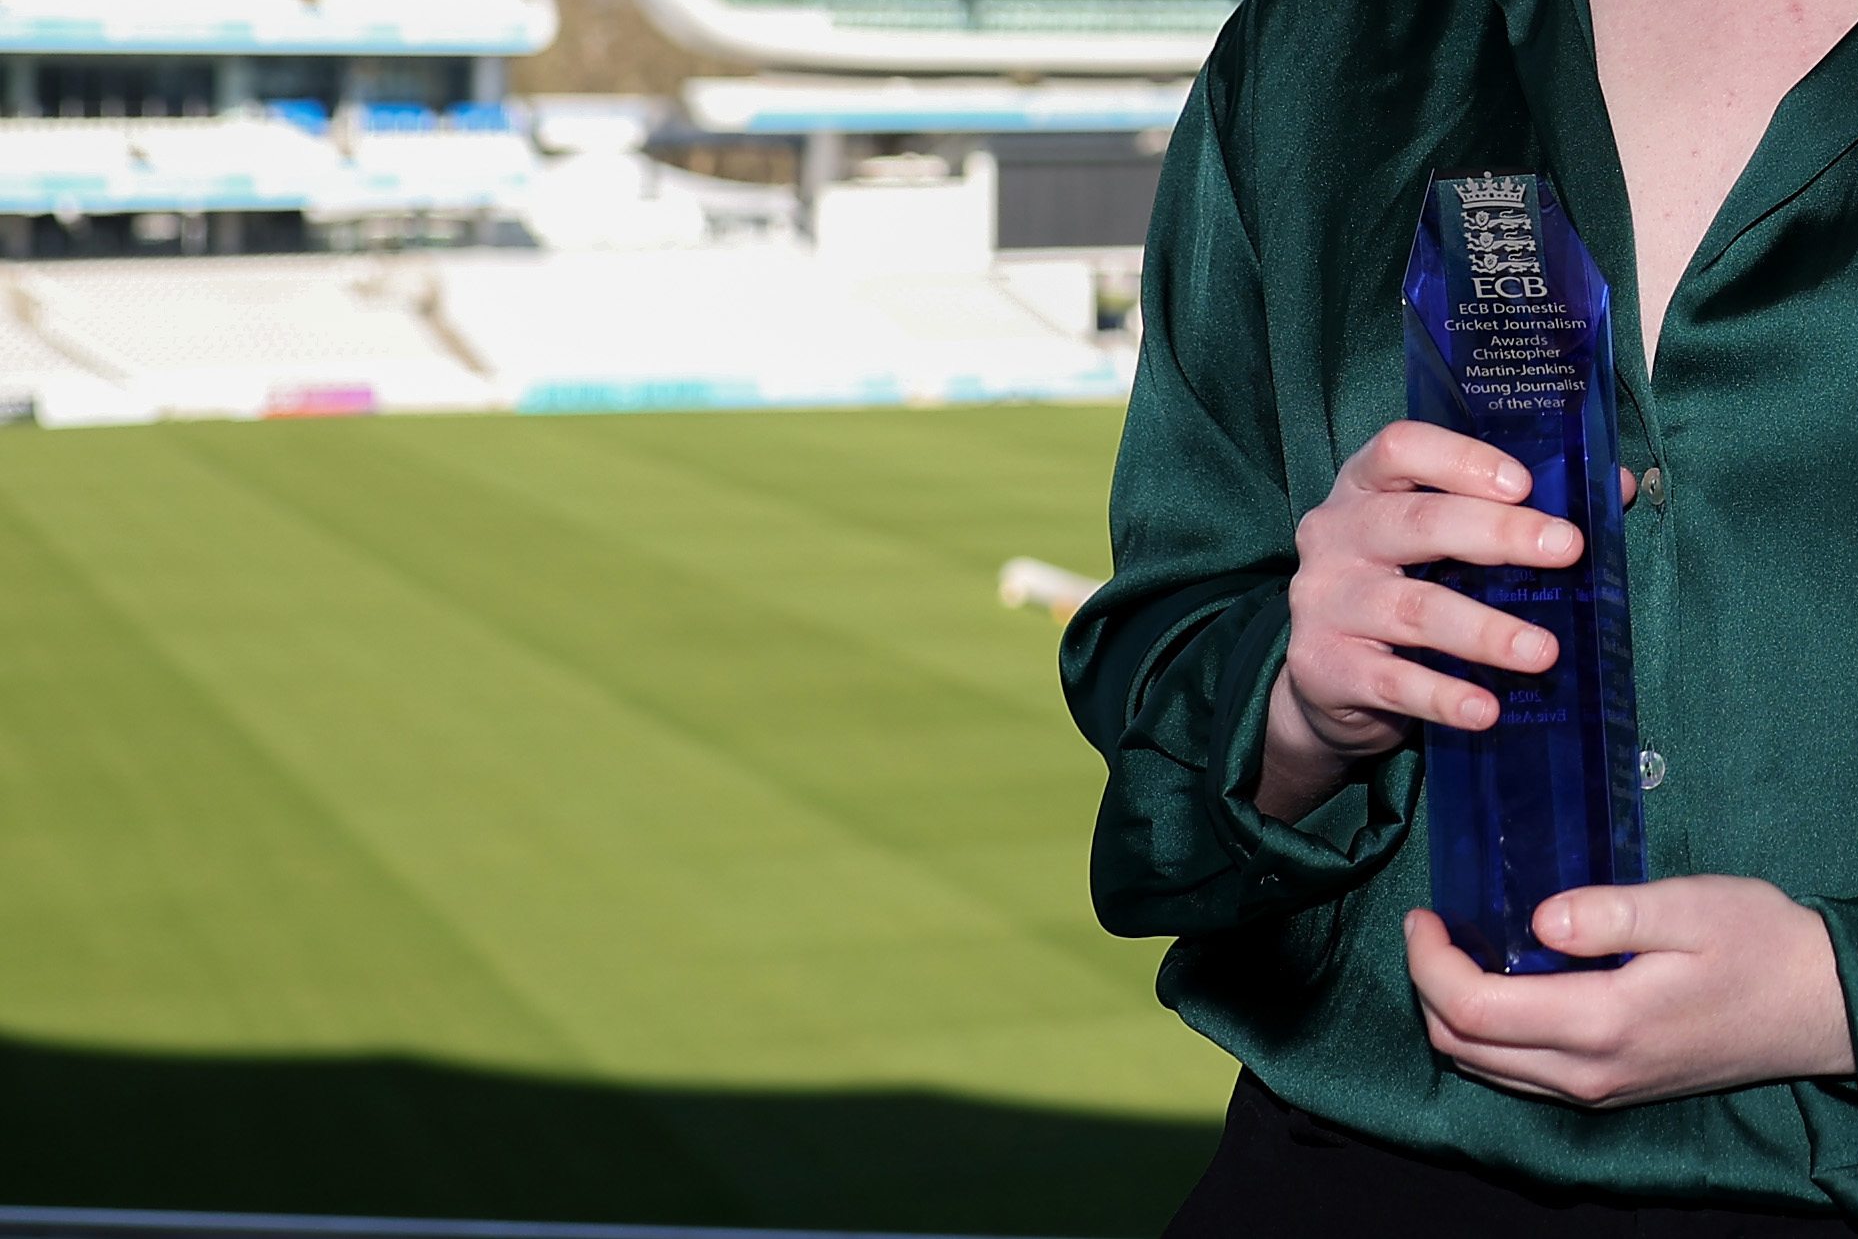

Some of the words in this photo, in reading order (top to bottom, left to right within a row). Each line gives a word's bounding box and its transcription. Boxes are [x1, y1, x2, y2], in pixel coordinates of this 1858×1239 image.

[1471, 276, 1548, 298] ECB
[1459, 303, 1489, 315] ECB
[1493, 302, 1567, 314] Domestic
[1444, 319, 1499, 331] Cricket
[1503, 318, 1587, 330] Journalism
[1490, 334, 1549, 347] Awards
[1472, 347, 1561, 361] Christopher
[1465, 363, 1576, 377] Martin-Jenkins
[1461, 382, 1511, 396] Young
[1514, 379, 1586, 393] Journalist
[1488, 398, 1503, 410] of
[1507, 397, 1532, 409] the
[1534, 397, 1566, 409] Year
